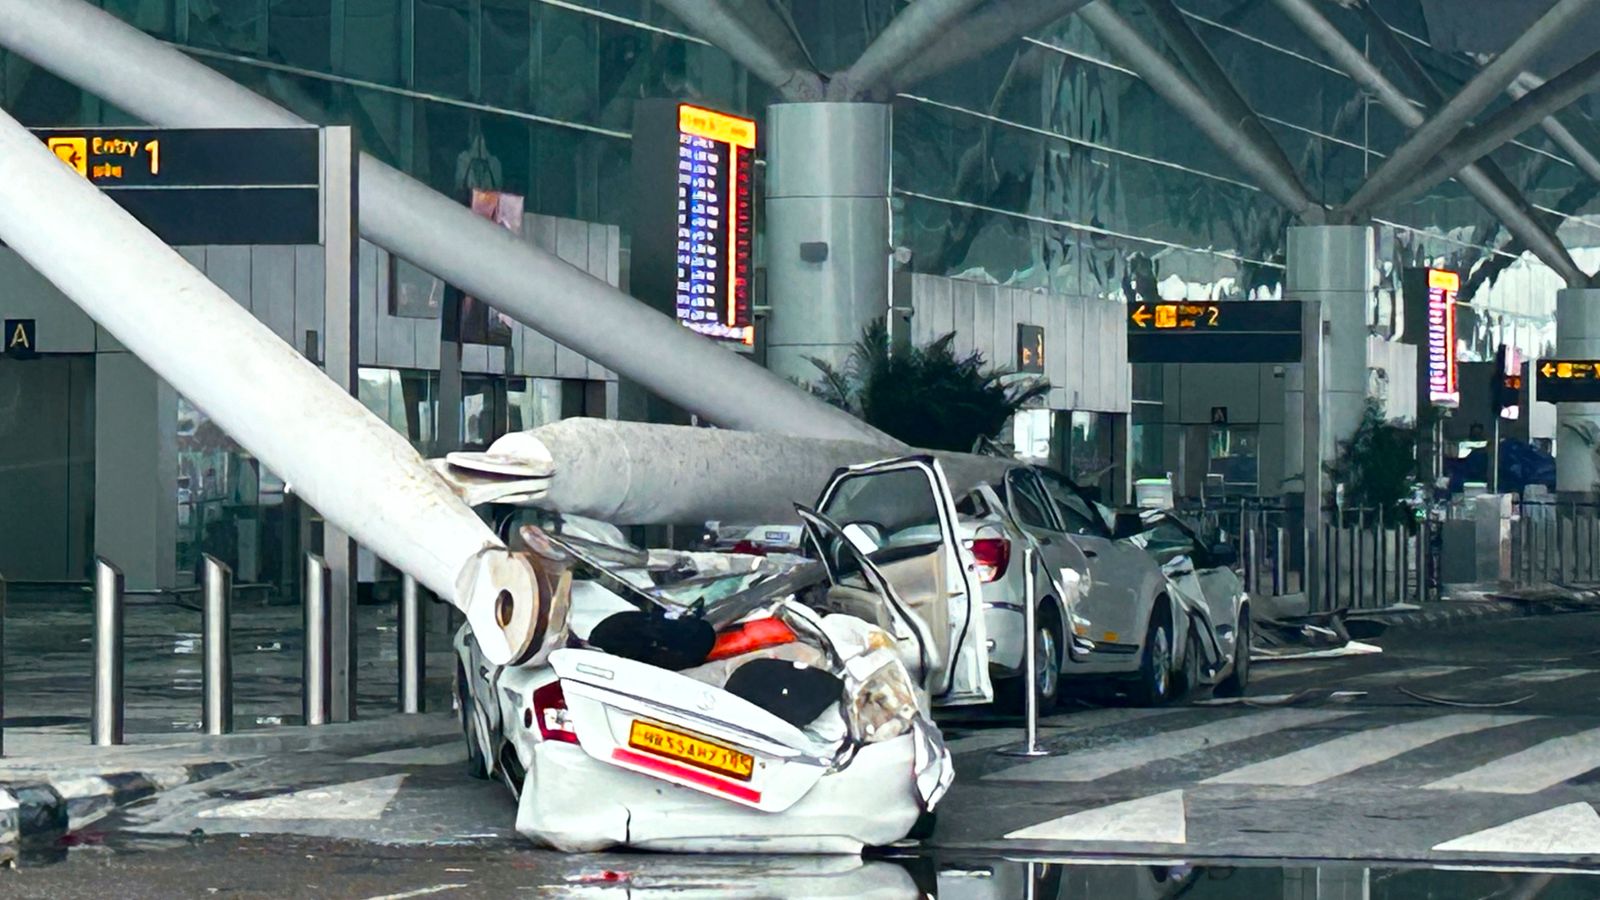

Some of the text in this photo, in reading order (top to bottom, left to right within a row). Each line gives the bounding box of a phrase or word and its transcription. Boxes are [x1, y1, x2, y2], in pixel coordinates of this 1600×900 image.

[92, 137, 138, 157] Entry
[144, 140, 159, 174] 1
[1207, 306, 1219, 326] 2
[10, 323, 29, 348] A
